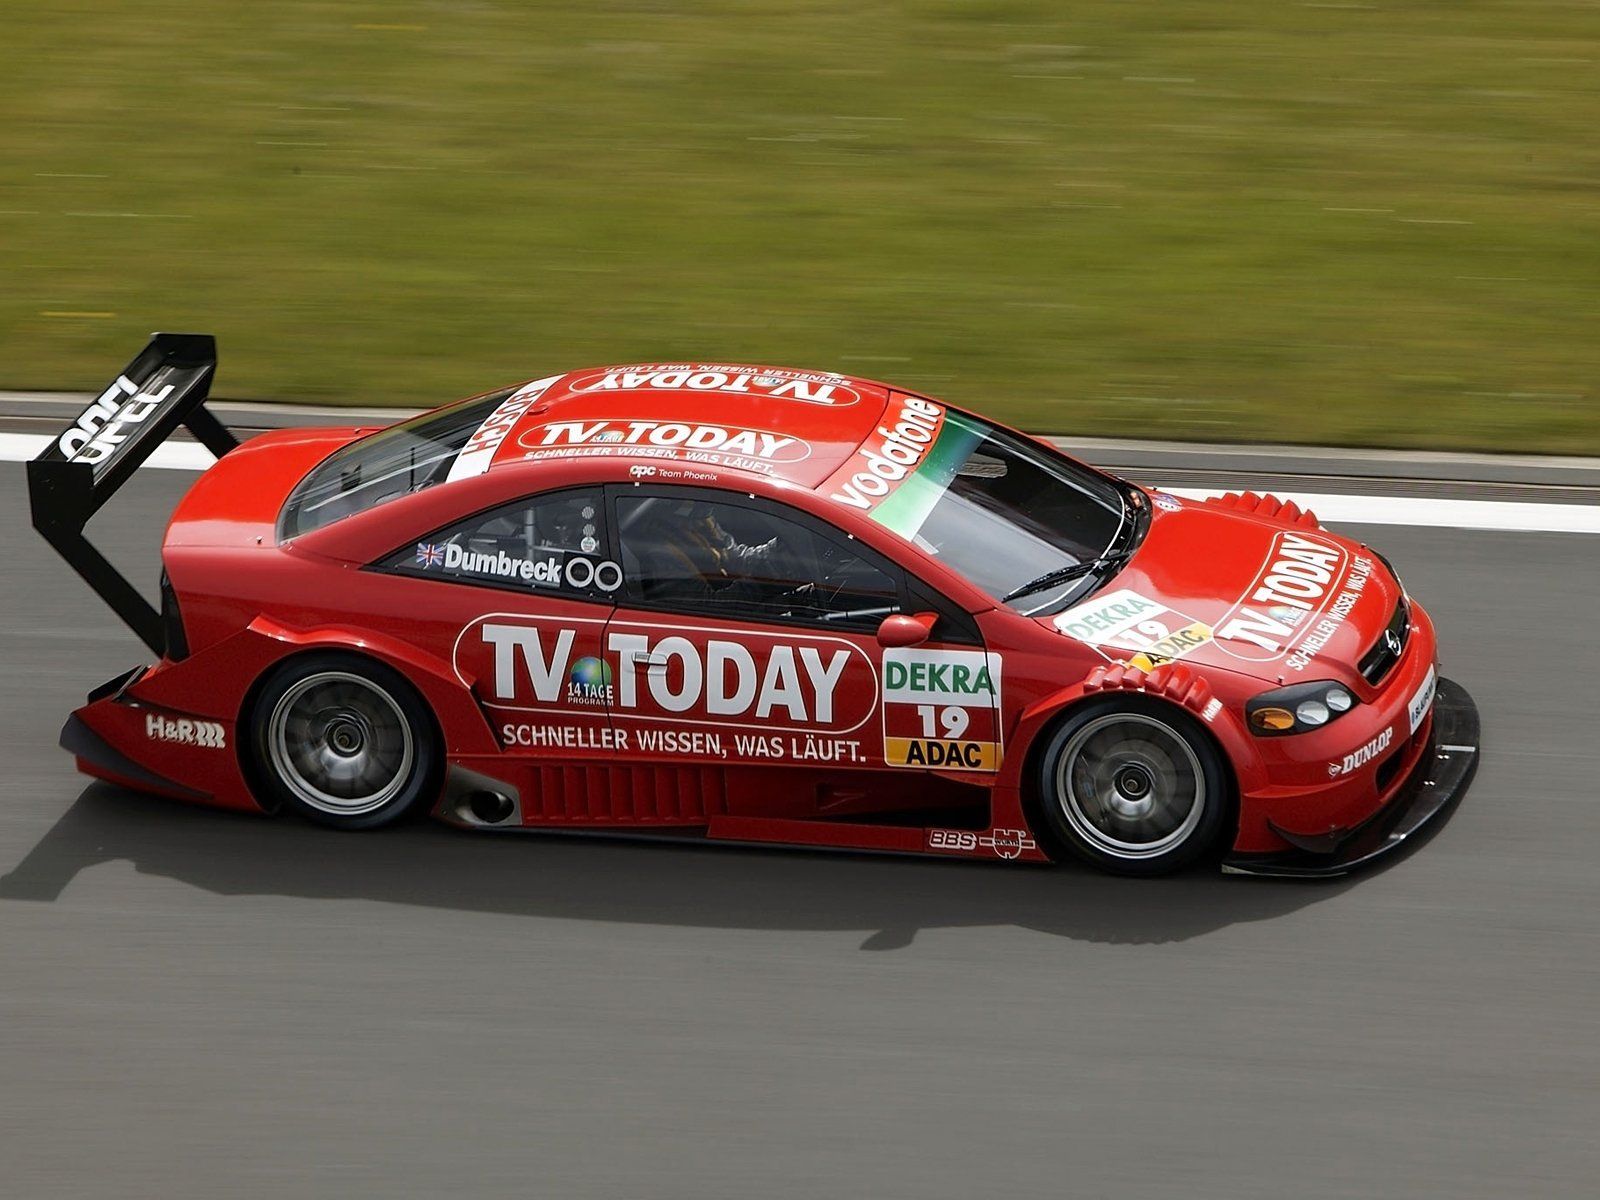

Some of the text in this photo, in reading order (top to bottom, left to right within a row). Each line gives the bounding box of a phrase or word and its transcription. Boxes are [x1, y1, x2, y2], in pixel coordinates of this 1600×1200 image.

[583, 371, 837, 405] TV TODAY
[462, 387, 546, 455] BOSCH
[540, 421, 798, 458] TV TODAY
[523, 447, 612, 460] SCHNELLER
[616, 447, 680, 461] WISSEN,
[685, 450, 720, 464] WAS
[830, 397, 942, 510] vodafone
[629, 465, 718, 481] opc Team Phoenix
[444, 543, 563, 583] Dumbreck
[1217, 533, 1341, 653] TV TODAY
[1065, 597, 1155, 640] DEKRA
[1114, 620, 1170, 648] 19
[1285, 618, 1340, 672] SCHNELLER
[1325, 590, 1363, 623] WISSEN,
[1345, 571, 1368, 592] WAS
[482, 623, 852, 724] TV TODAY
[567, 681, 614, 700] 14 TAGE
[885, 660, 997, 697] DEKRA
[917, 704, 970, 740] 19
[502, 724, 867, 763] SCHNELLER WISSEN, WAS LÄUFT.
[906, 740, 982, 768] ADAC
[1341, 726, 1394, 775] DUNLOP
[929, 829, 977, 850] BBS
